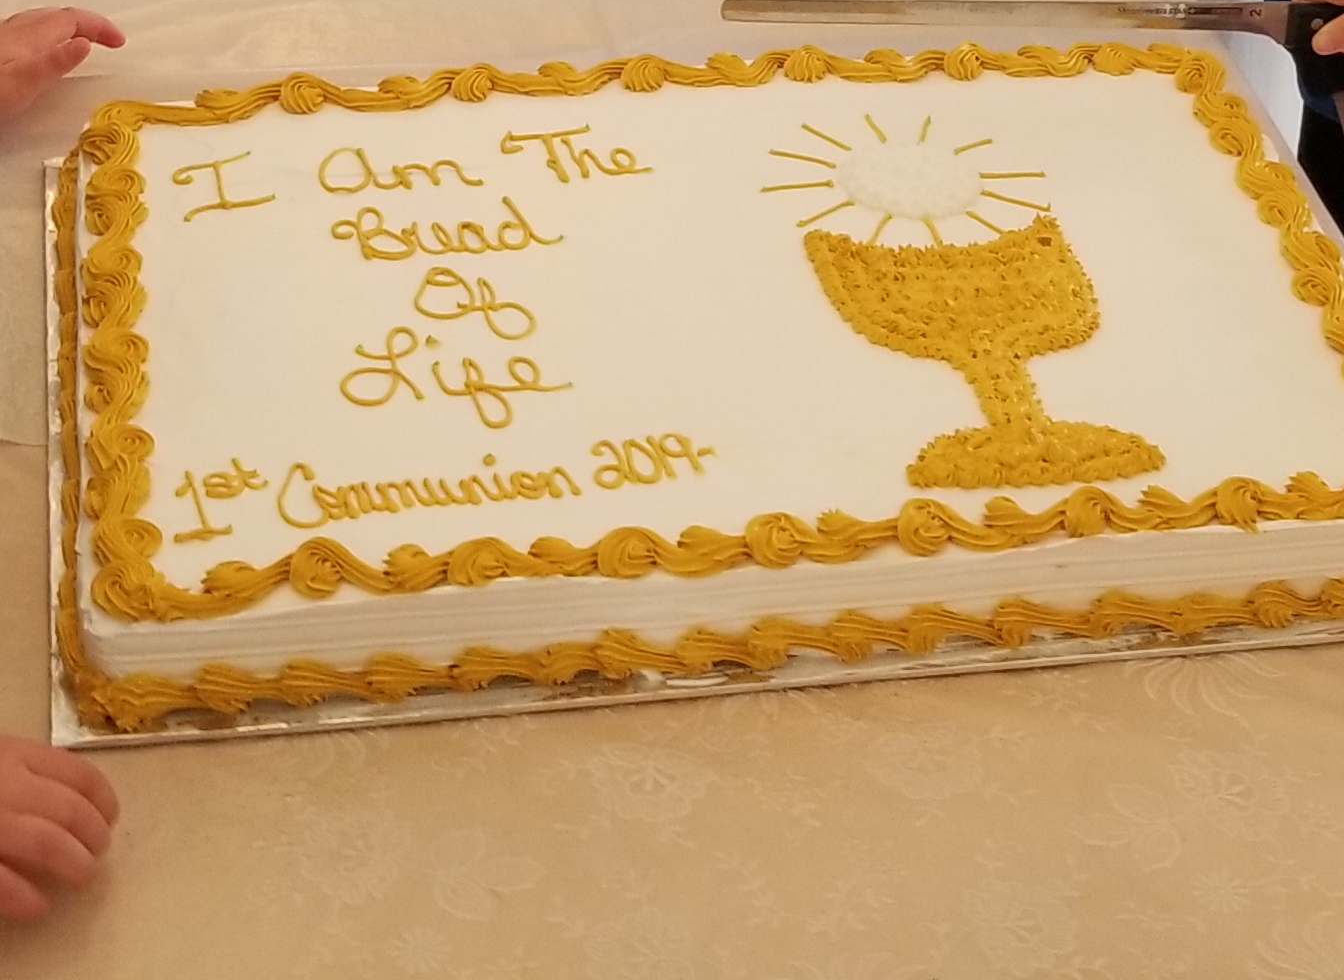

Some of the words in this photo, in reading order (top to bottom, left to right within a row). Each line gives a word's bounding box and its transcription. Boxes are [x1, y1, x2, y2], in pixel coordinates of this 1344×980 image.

[171, 150, 276, 222] I
[499, 123, 654, 184] The
[331, 195, 564, 261] Bread
[413, 265, 537, 341] Of
[339, 326, 573, 430] Life
[173, 457, 270, 544] 1st
[276, 452, 583, 530] Communion
